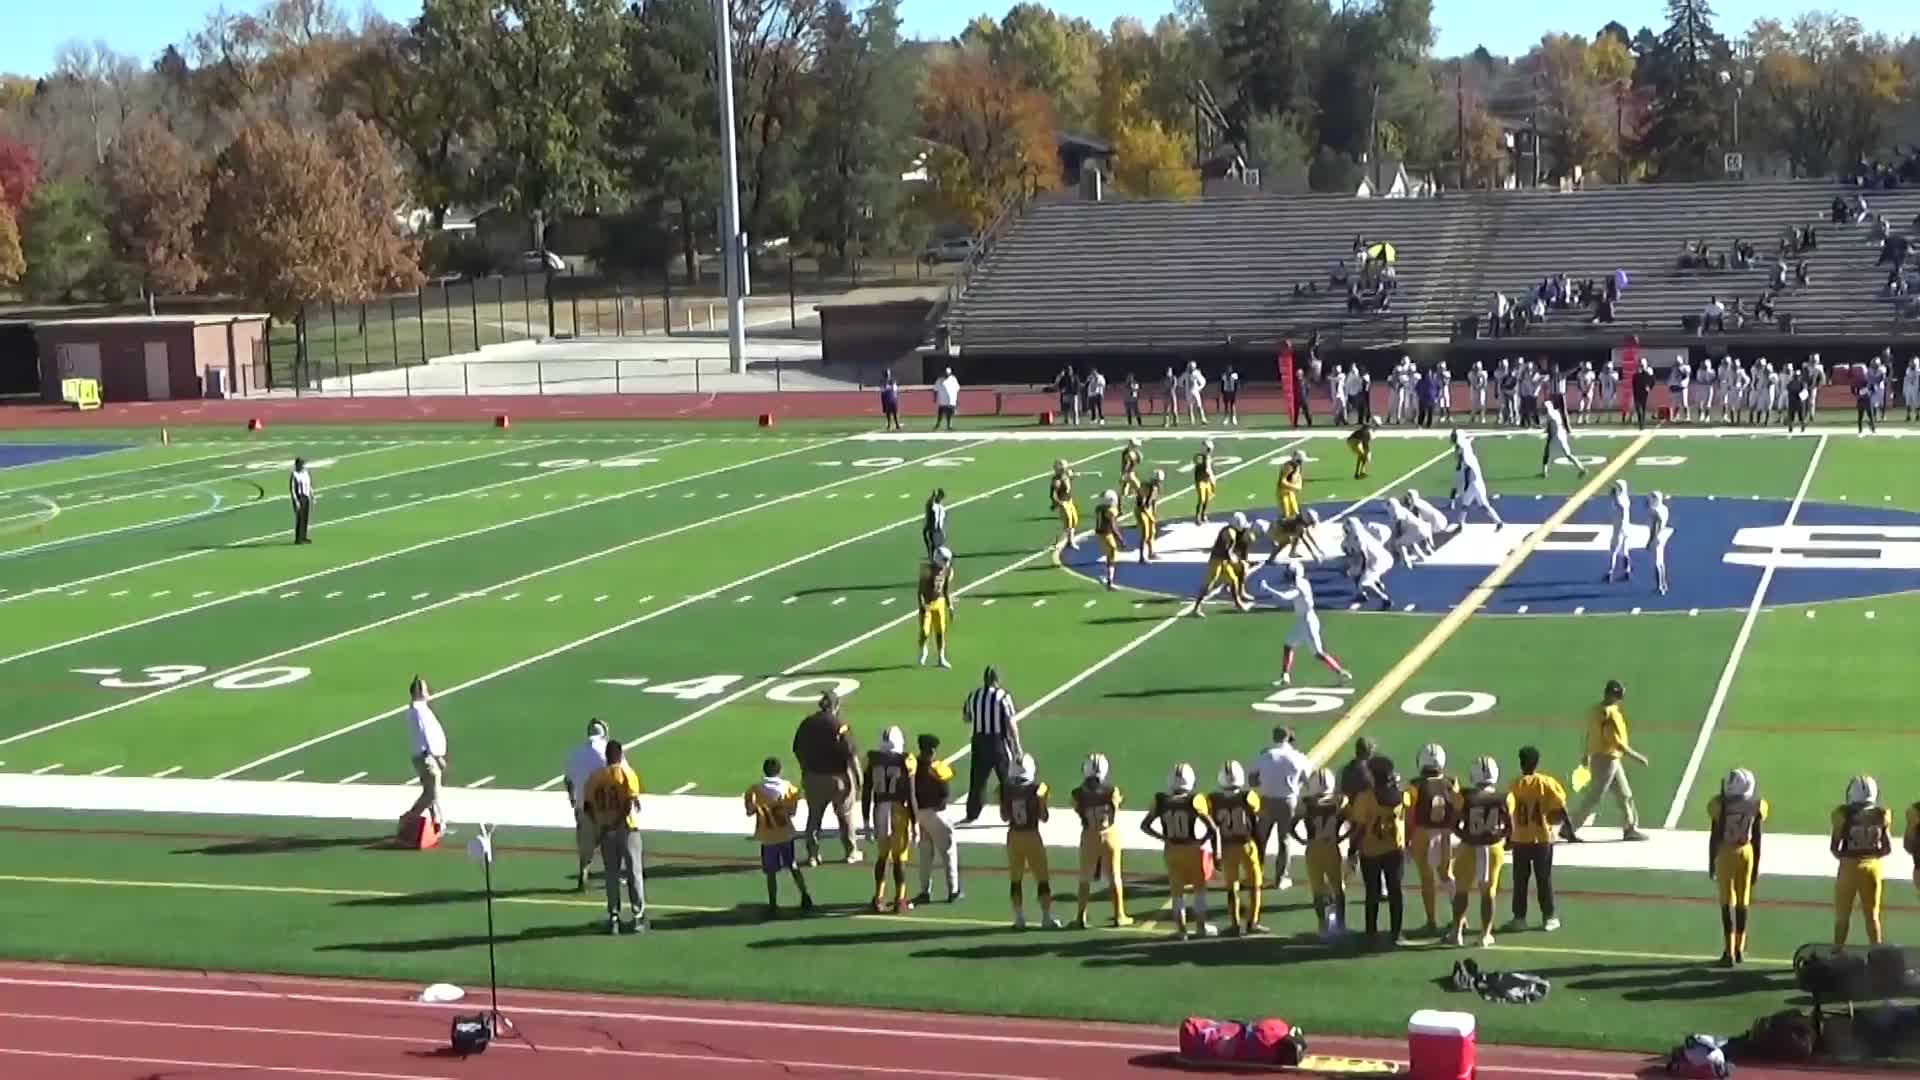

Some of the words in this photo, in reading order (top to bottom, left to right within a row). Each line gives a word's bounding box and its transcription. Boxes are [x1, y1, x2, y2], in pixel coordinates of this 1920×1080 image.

[95, 665, 311, 690] 30
[643, 673, 860, 703] 40
[1251, 687, 1498, 716] 50
